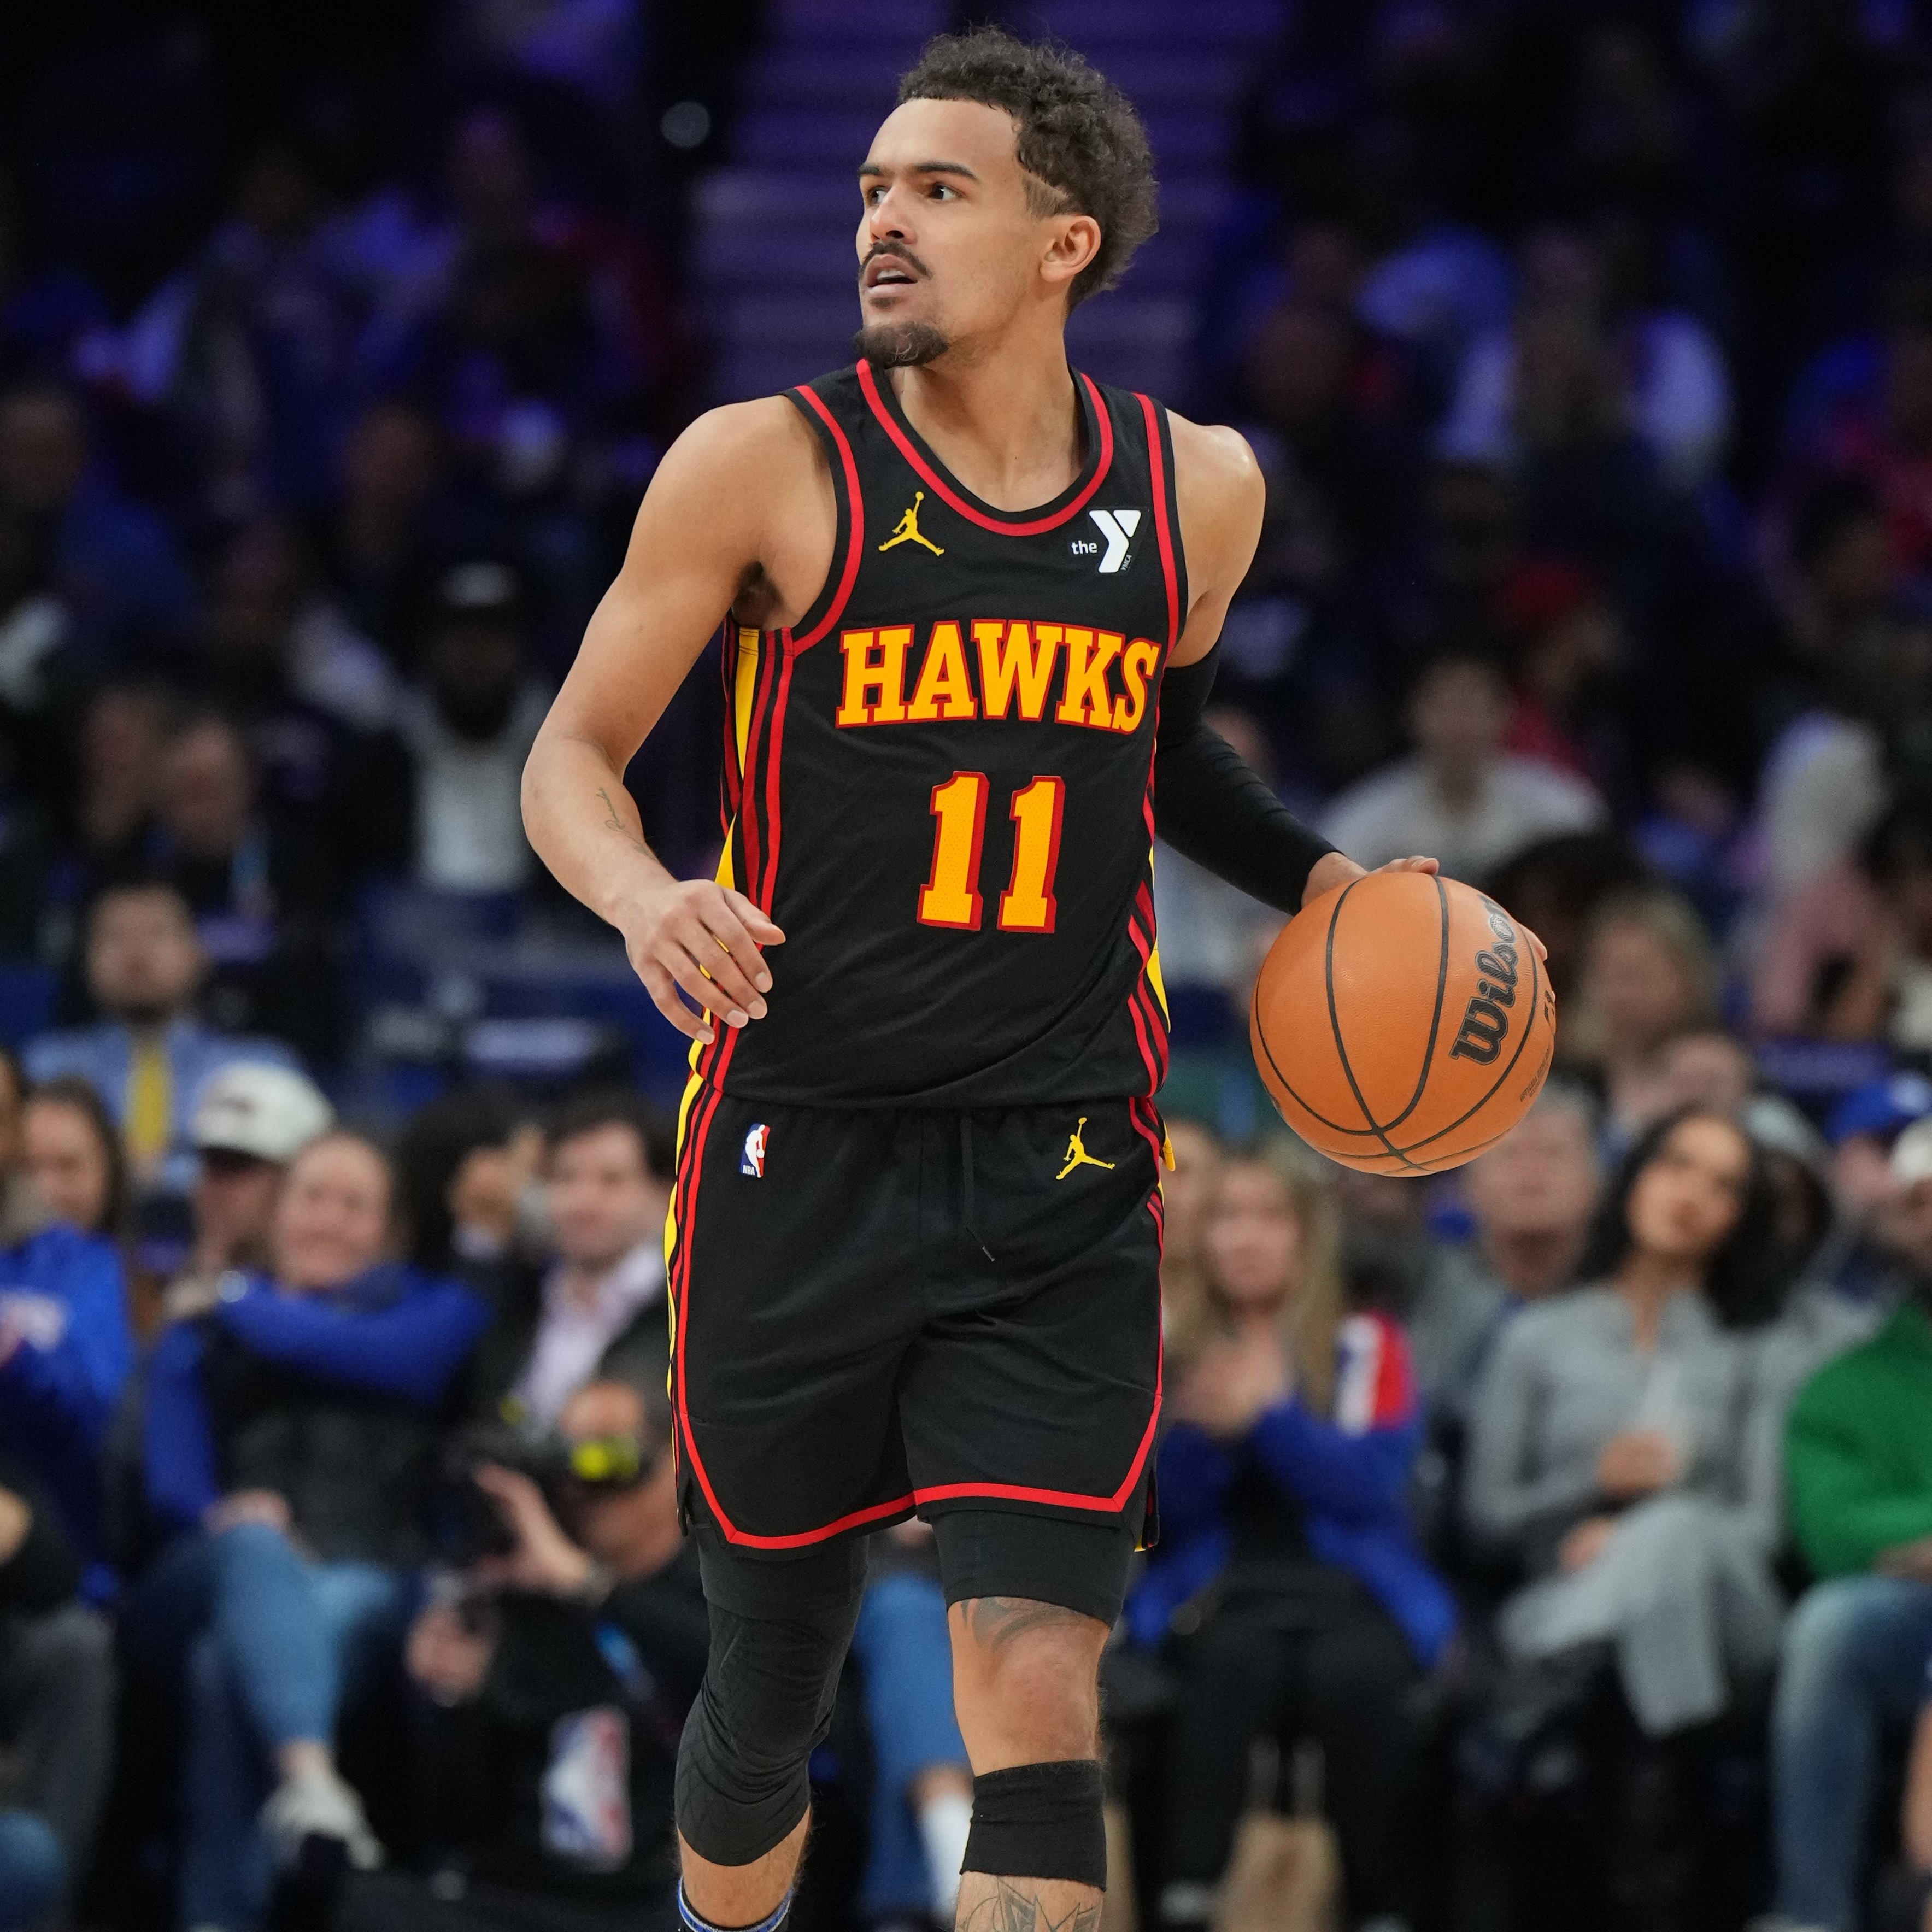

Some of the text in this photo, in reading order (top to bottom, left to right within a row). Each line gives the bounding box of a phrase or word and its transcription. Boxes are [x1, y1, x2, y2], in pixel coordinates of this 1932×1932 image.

[1071, 509, 1142, 573] the Y
[1120, 554, 1132, 571] YMCA
[836, 619, 1162, 735] HAWKS
[917, 771, 1066, 933] 11
[742, 1164, 756, 1176] NBA
